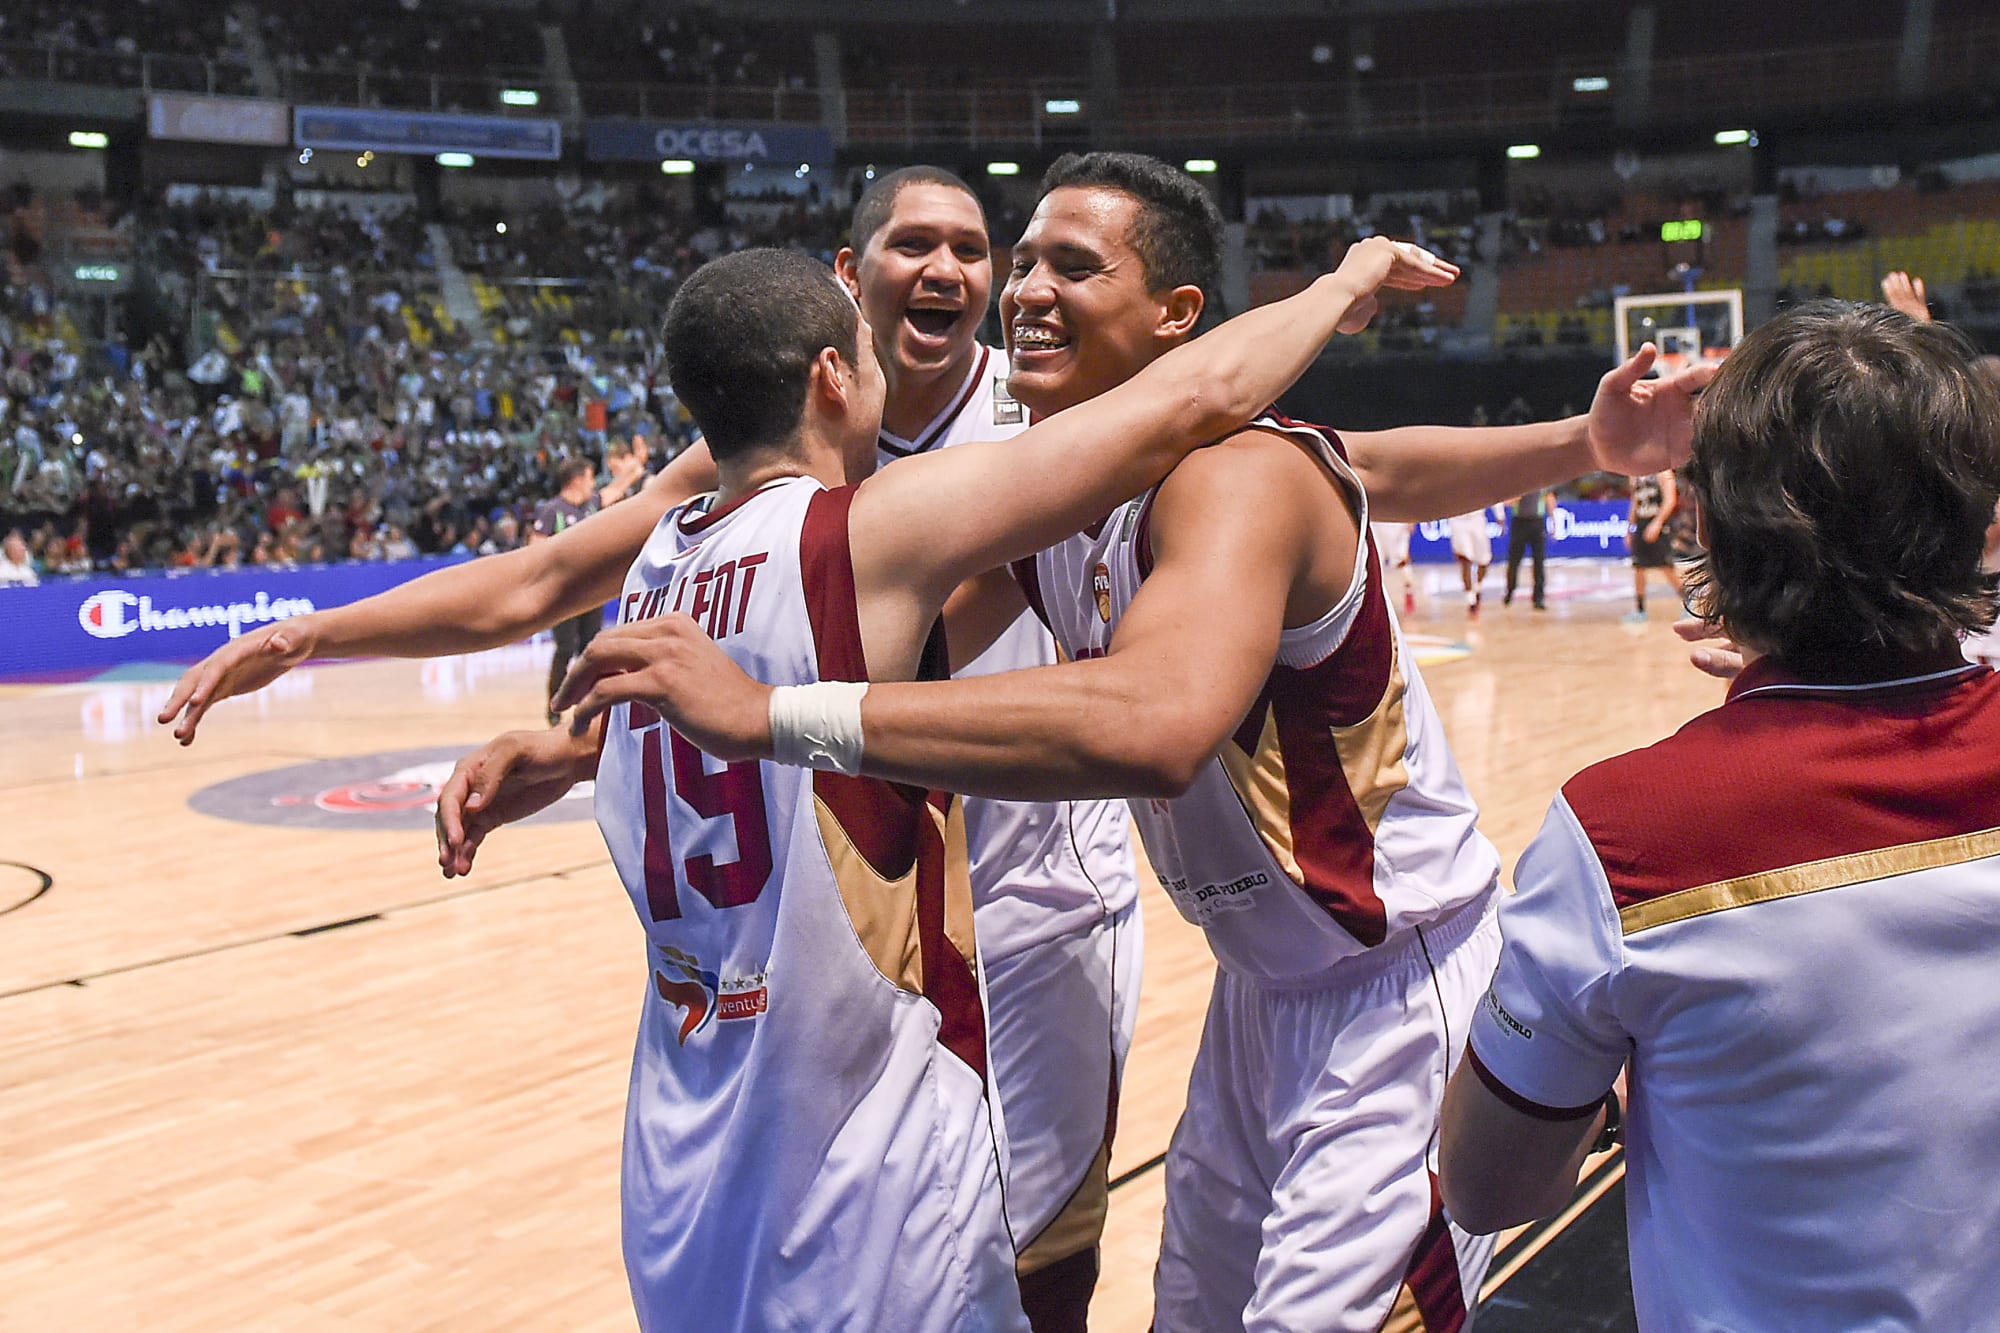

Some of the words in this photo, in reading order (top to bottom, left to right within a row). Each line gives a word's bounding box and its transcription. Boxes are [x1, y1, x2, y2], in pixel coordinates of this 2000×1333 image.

[655, 129, 768, 157] OCESA
[997, 403, 1019, 413] FIBA
[1094, 575, 1110, 591] FVB
[79, 590, 315, 638] Champion
[630, 700, 773, 922] 19
[1195, 884, 1221, 901] DEL
[1499, 1004, 1532, 1039] PUEBLO
